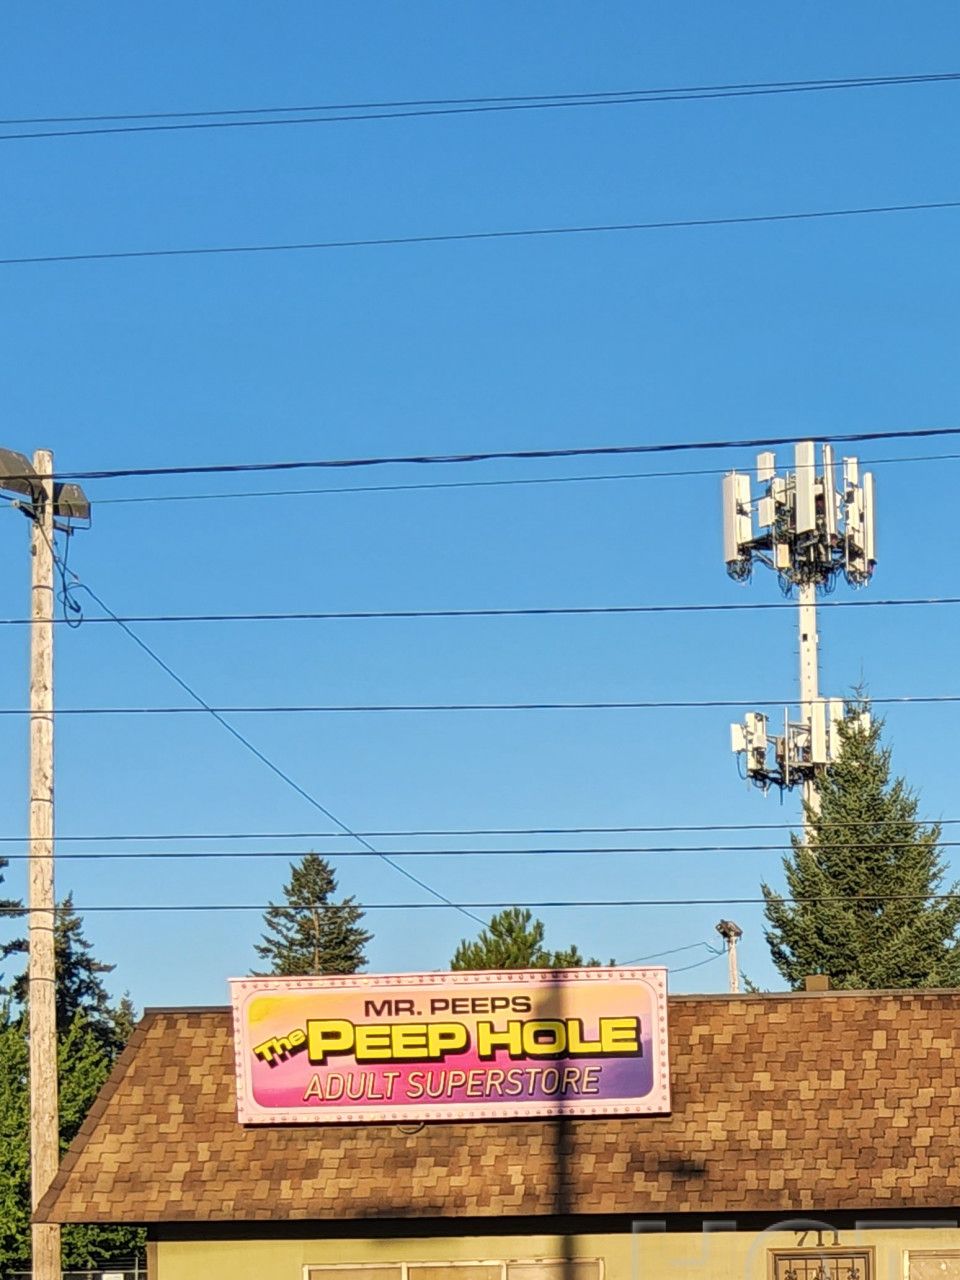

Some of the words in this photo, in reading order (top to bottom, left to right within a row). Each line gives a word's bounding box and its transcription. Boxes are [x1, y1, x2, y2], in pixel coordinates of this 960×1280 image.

[364, 998, 422, 1017] MR.
[430, 996, 532, 1015] PEEPS
[252, 1028, 308, 1068] The
[306, 1018, 470, 1066] PEEP
[476, 1016, 643, 1060] HOLE
[302, 1071, 402, 1102] ADULT
[405, 1066, 602, 1099] SUPERSTORE
[794, 1230, 841, 1247] 711
